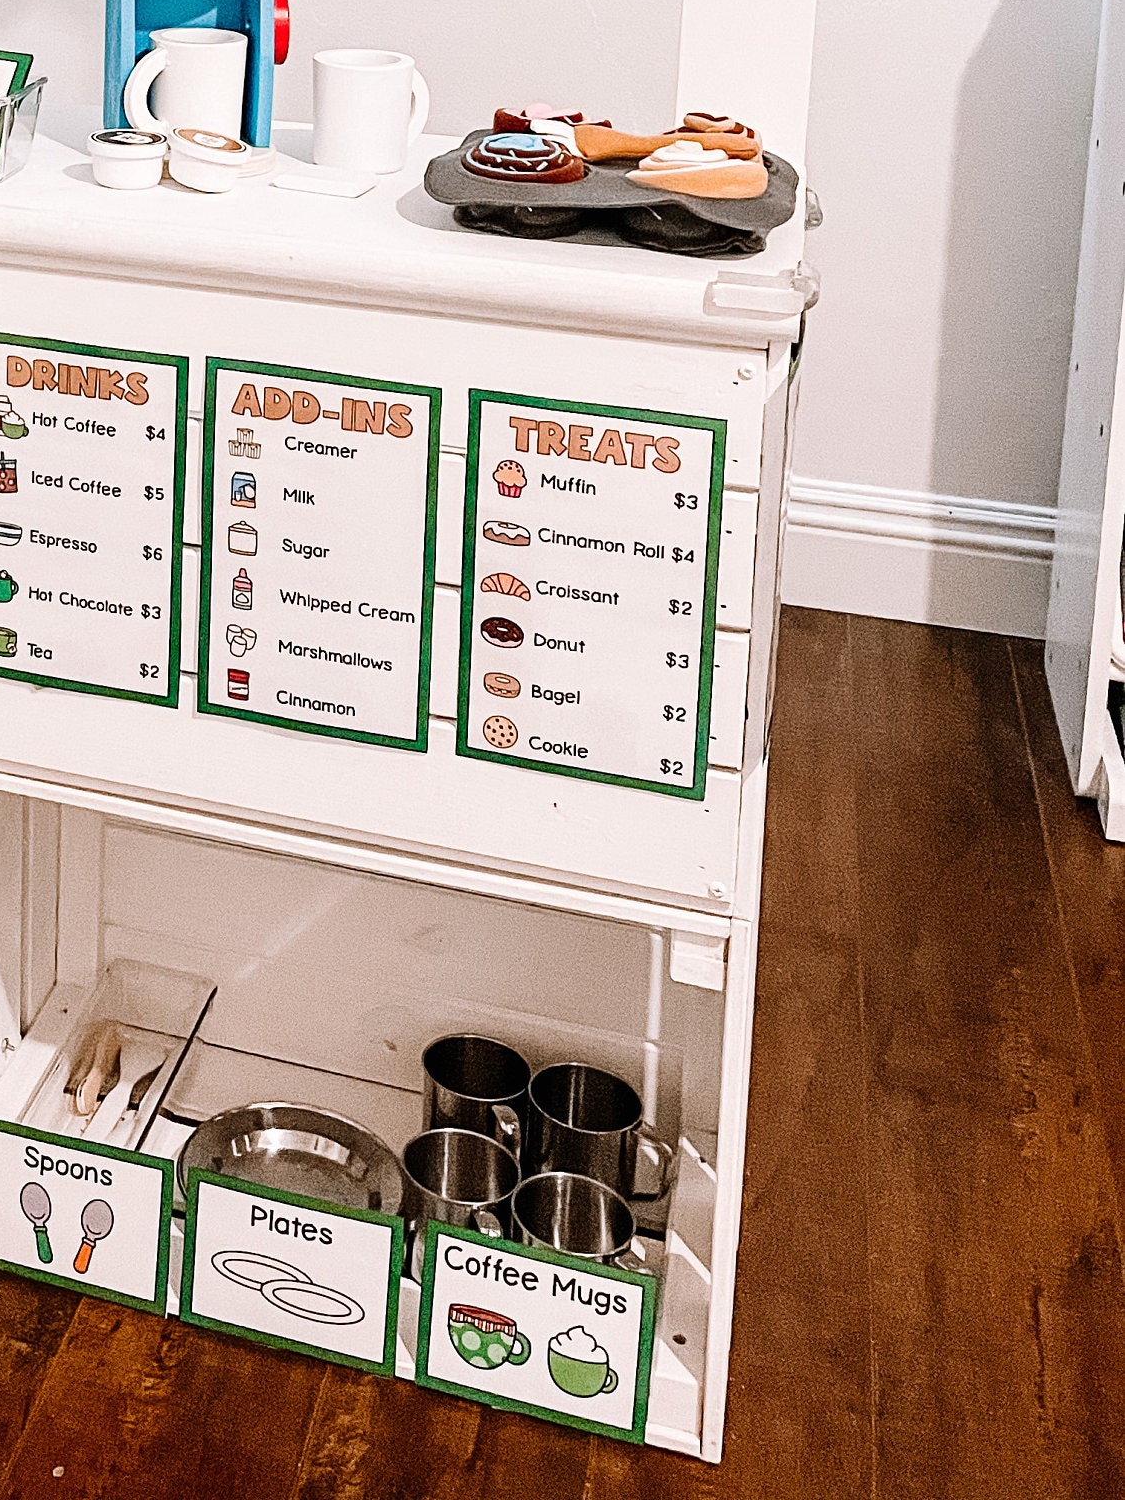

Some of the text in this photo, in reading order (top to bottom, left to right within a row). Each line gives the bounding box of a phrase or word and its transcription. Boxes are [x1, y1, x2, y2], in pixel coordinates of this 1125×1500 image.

[6, 355, 150, 406] DRINKS
[33, 412, 165, 441] Hot Coffee $4
[231, 383, 413, 439] ADD-INS
[284, 436, 358, 460] Creamer
[509, 415, 682, 475] TREATS
[32, 471, 164, 501] Iced Coffee $5
[283, 488, 315, 505] Milk
[540, 473, 698, 510] Muffin $3
[29, 529, 162, 560] Espresso $6
[281, 538, 330, 560] Sugar
[538, 527, 694, 563] Cinnamon Roll $4
[29, 586, 161, 619] Hot Chocolate $3
[279, 588, 416, 624] Whipped Cream
[536, 580, 692, 615] Croissant $2
[27, 643, 159, 678] Tea $2
[278, 639, 393, 672] Marshmallows
[533, 632, 689, 668] Donut $3
[276, 690, 356, 717] Cinnamon
[532, 684, 686, 722] Bagel $2
[529, 736, 683, 776] Cookie $2
[23, 1146, 114, 1188] Spoons
[251, 1205, 333, 1245] Plates
[444, 1245, 628, 1318] Coffee Mugs
